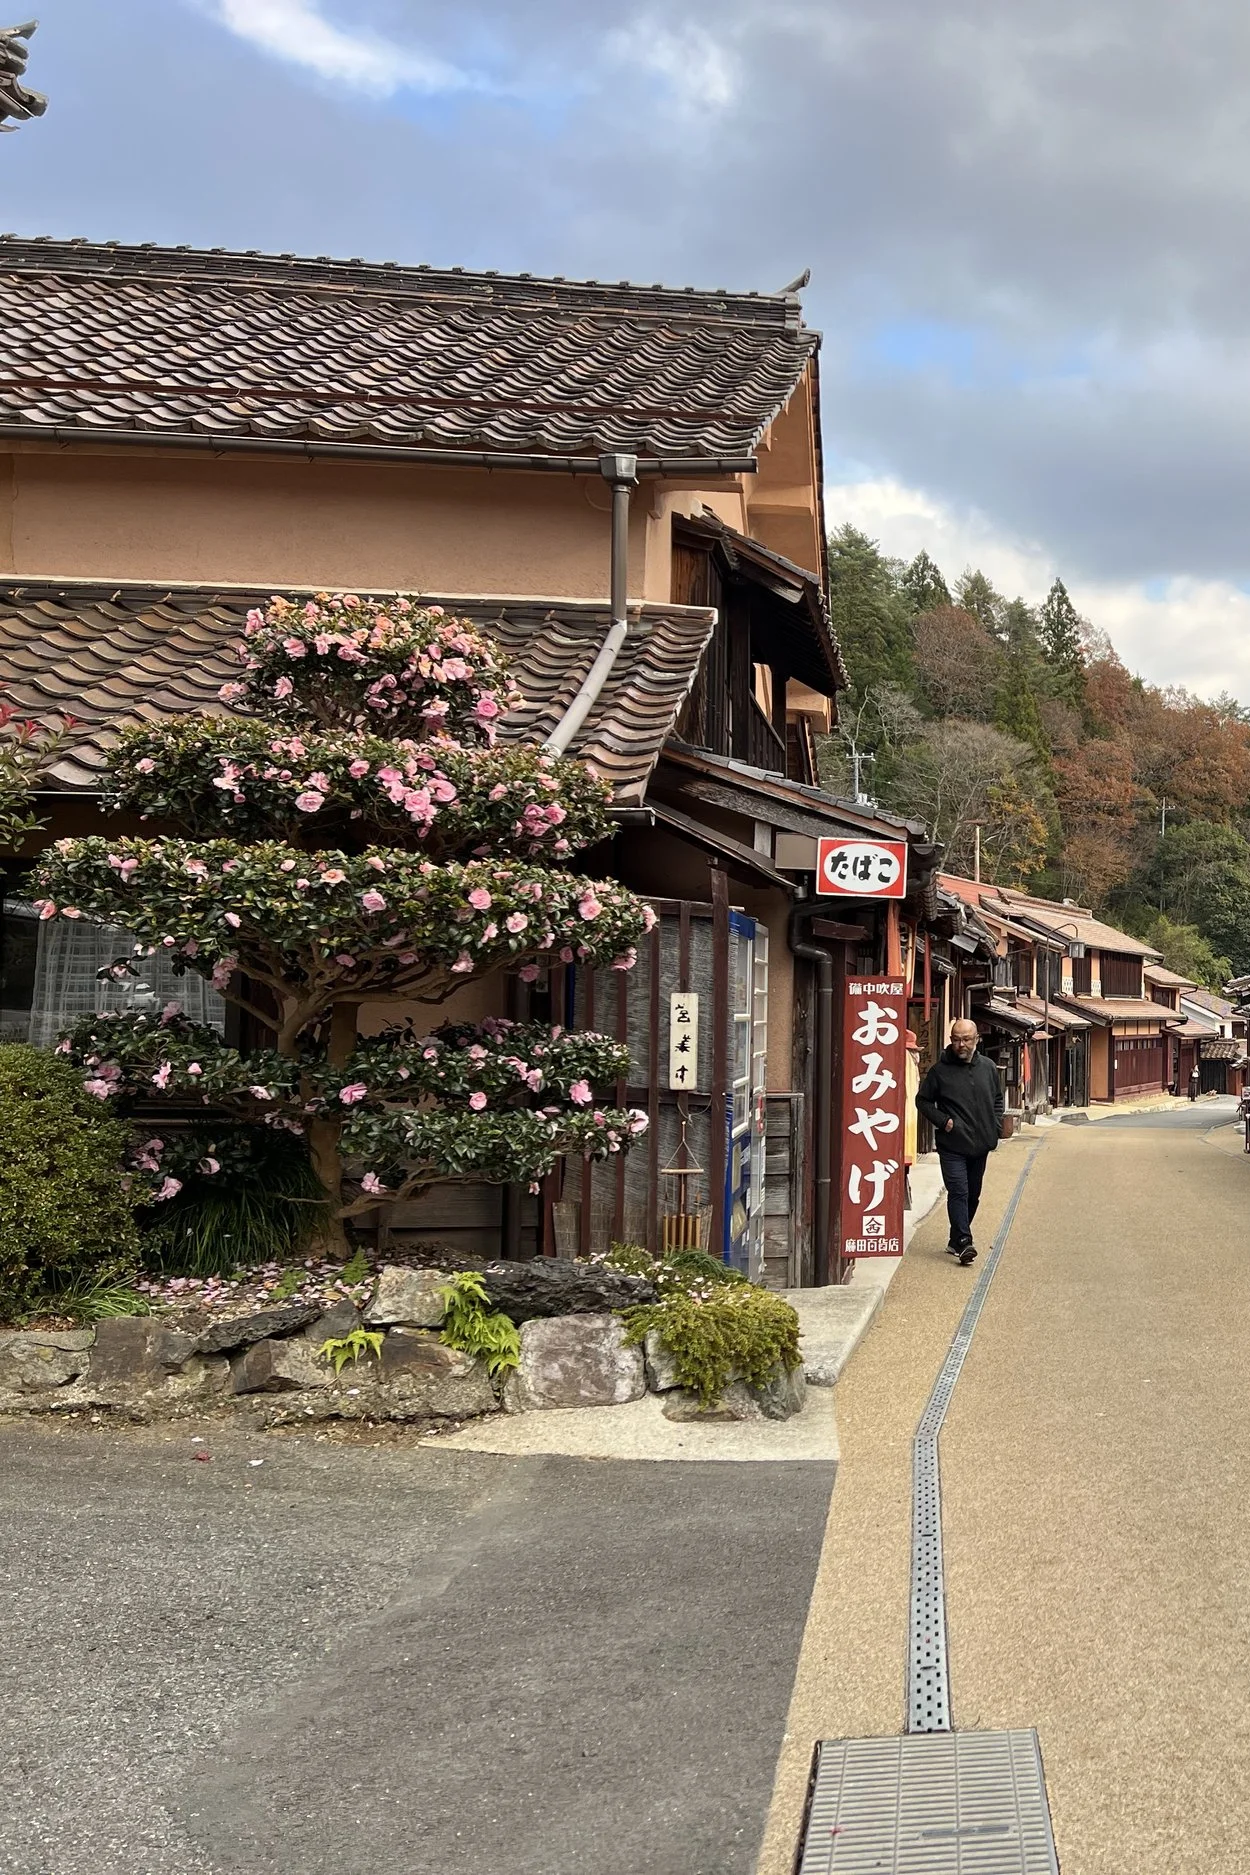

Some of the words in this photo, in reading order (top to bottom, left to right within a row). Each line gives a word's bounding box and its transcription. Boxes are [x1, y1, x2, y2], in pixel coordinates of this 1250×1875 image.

[830, 851, 893, 884] たばこ
[848, 982, 904, 996] 備中吹屋
[847, 1000, 900, 1213] おみやげ
